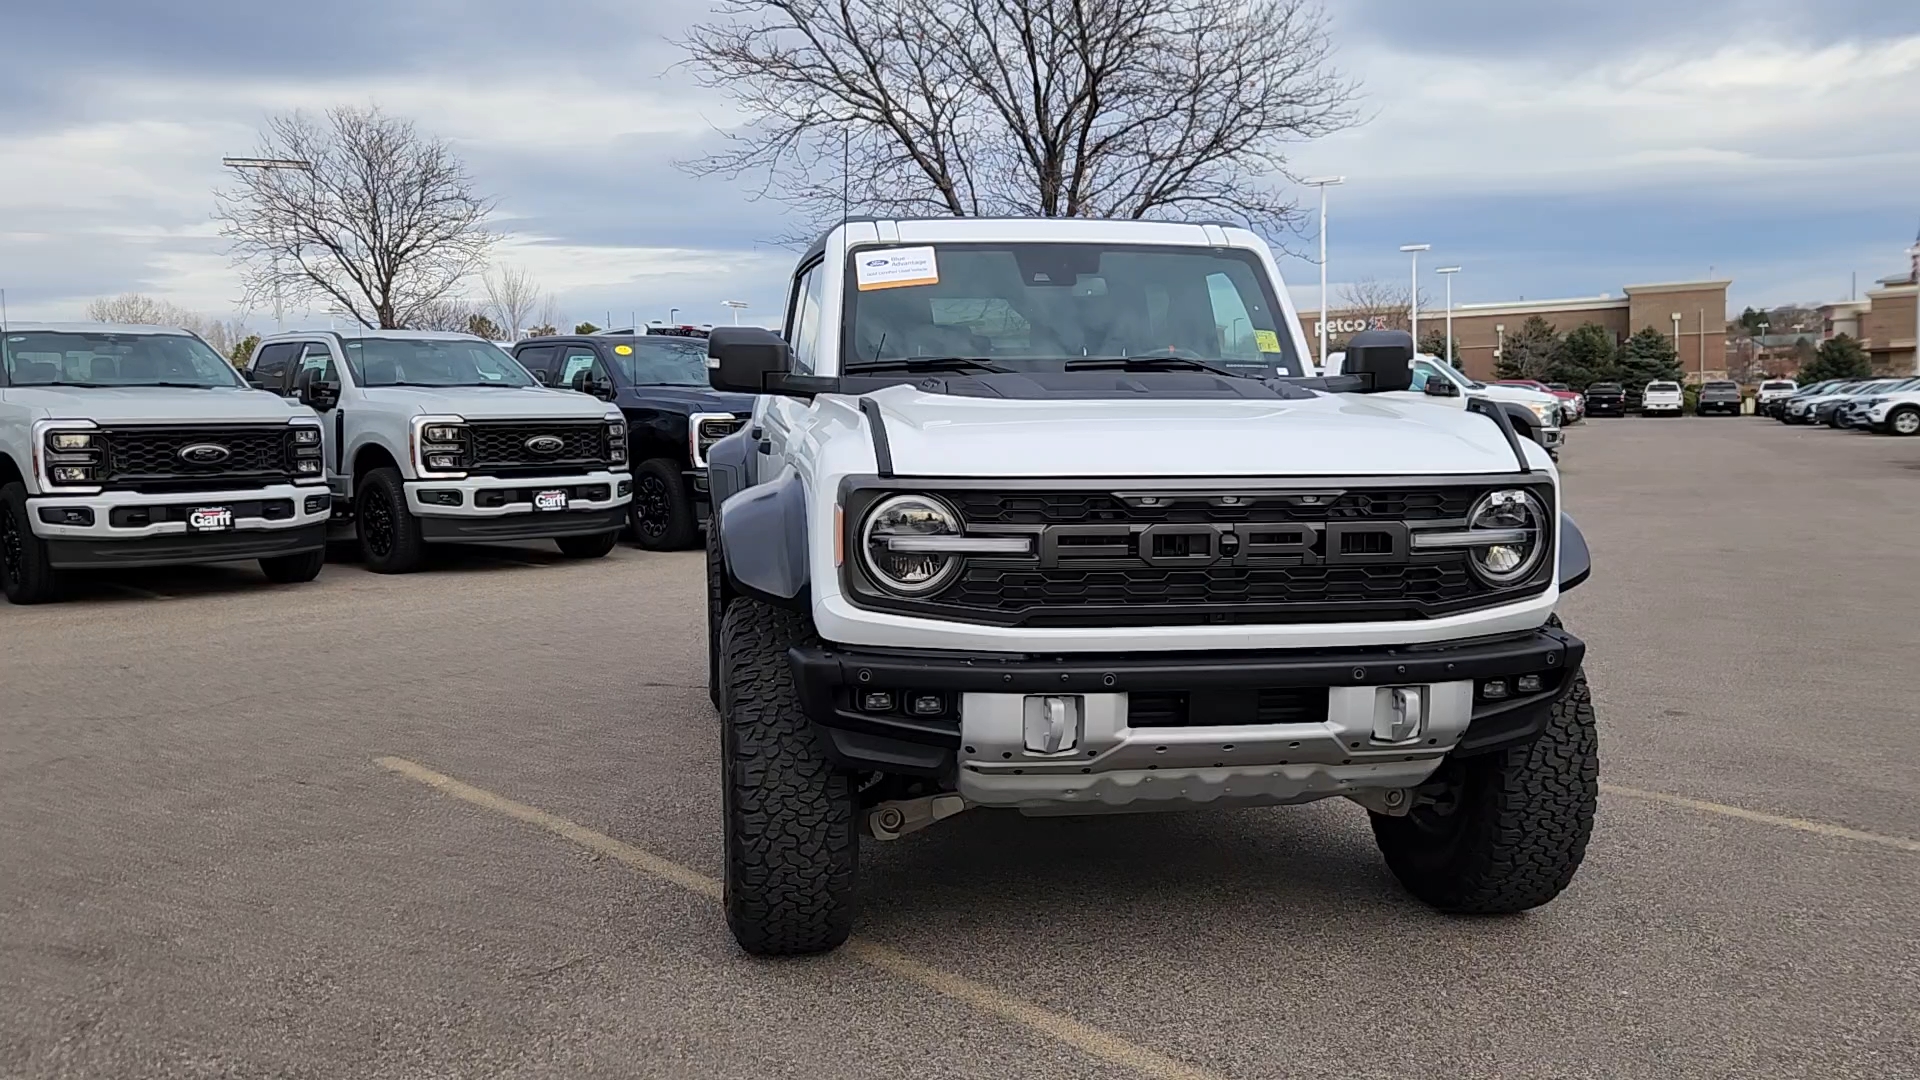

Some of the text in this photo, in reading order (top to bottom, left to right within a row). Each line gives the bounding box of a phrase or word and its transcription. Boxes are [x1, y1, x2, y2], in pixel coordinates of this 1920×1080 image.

[535, 494, 566, 507] Garff
[190, 511, 231, 527] Garff
[1039, 521, 1409, 567] FORD
